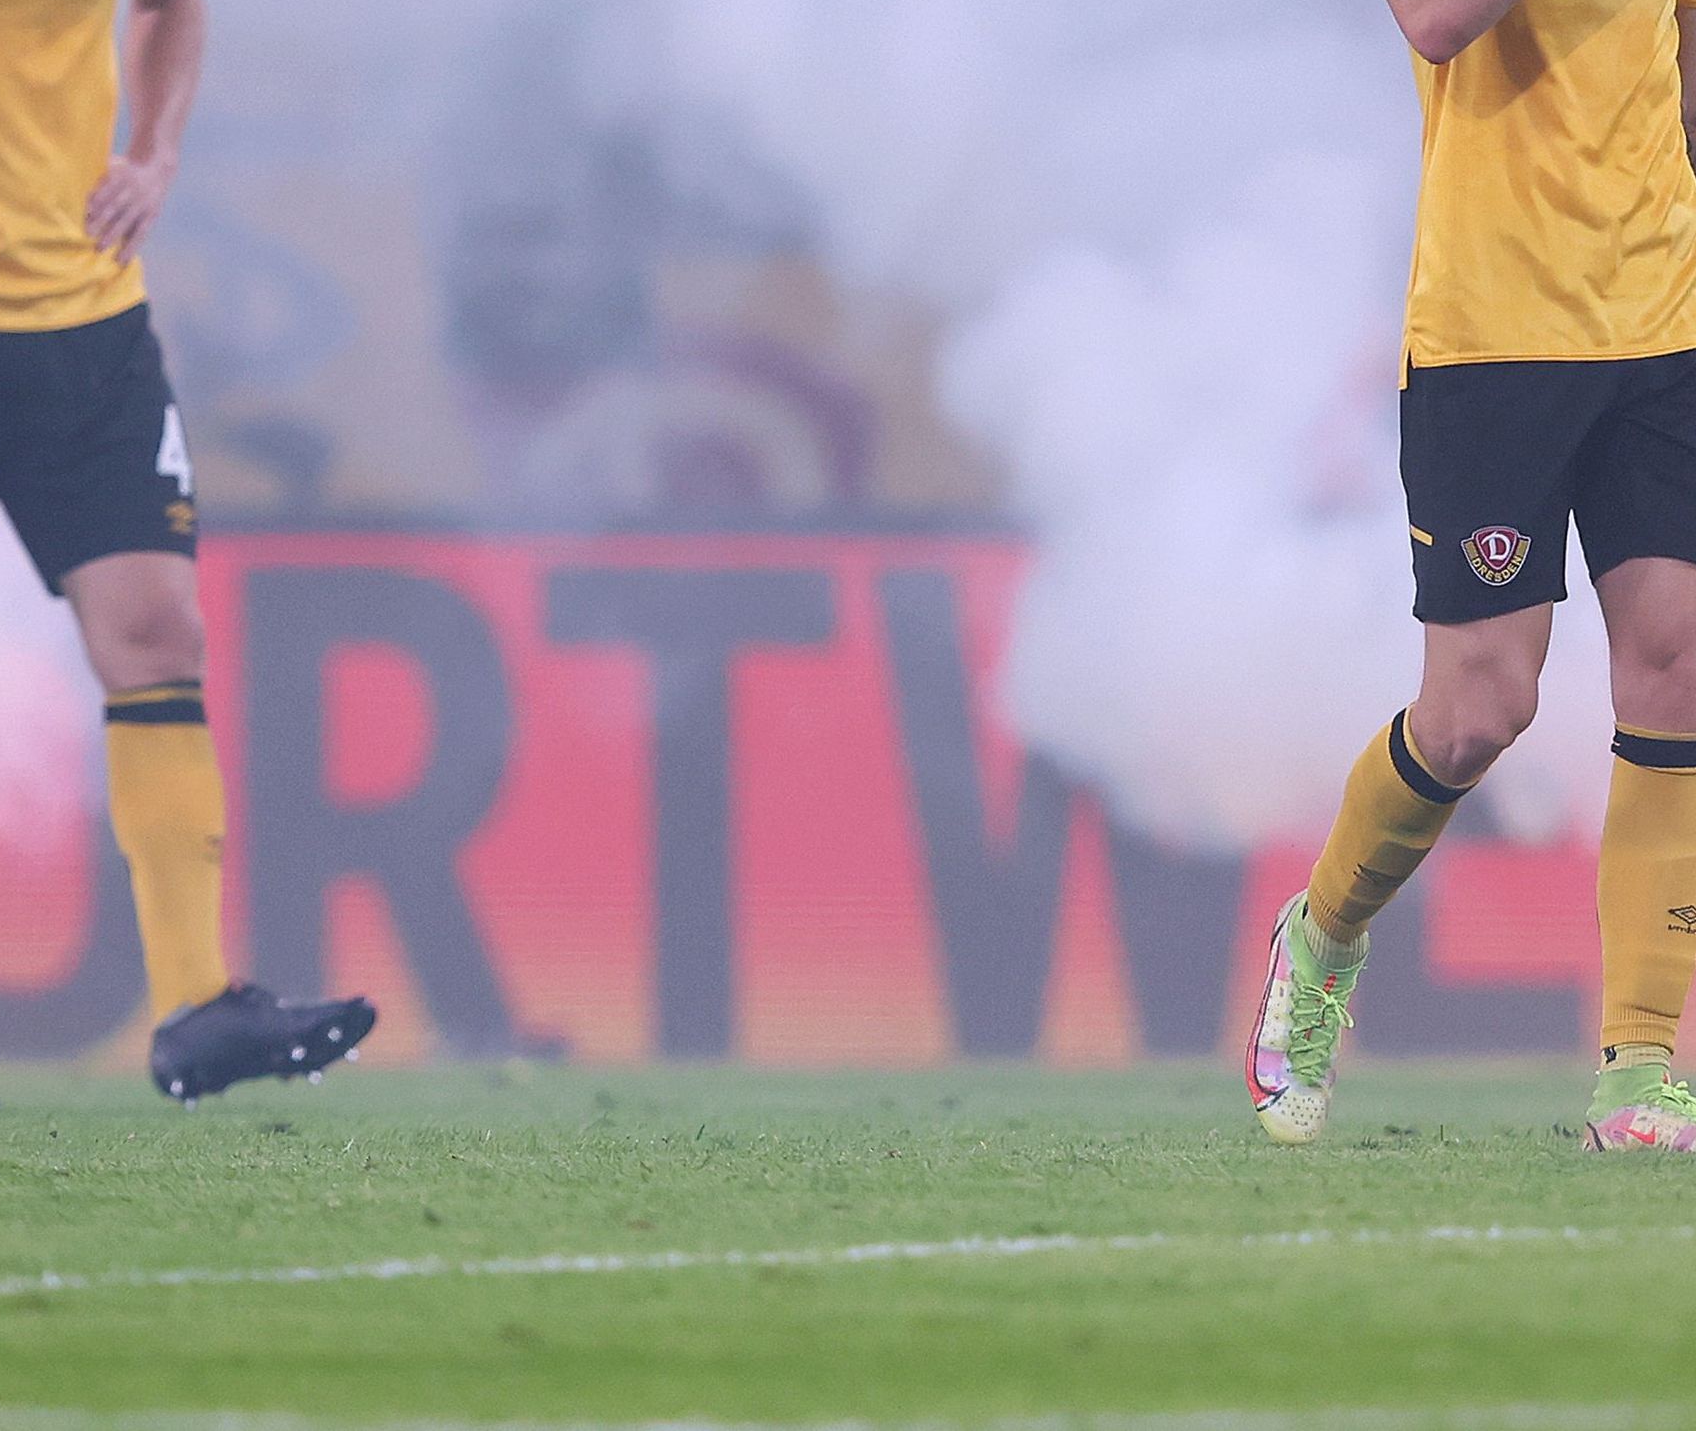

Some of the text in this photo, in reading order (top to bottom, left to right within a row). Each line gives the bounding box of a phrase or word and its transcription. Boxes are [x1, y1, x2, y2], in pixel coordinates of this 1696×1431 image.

[156, 403, 193, 496] 4
[1481, 531, 1511, 561] D
[1472, 555, 1522, 582] DRESDEN
